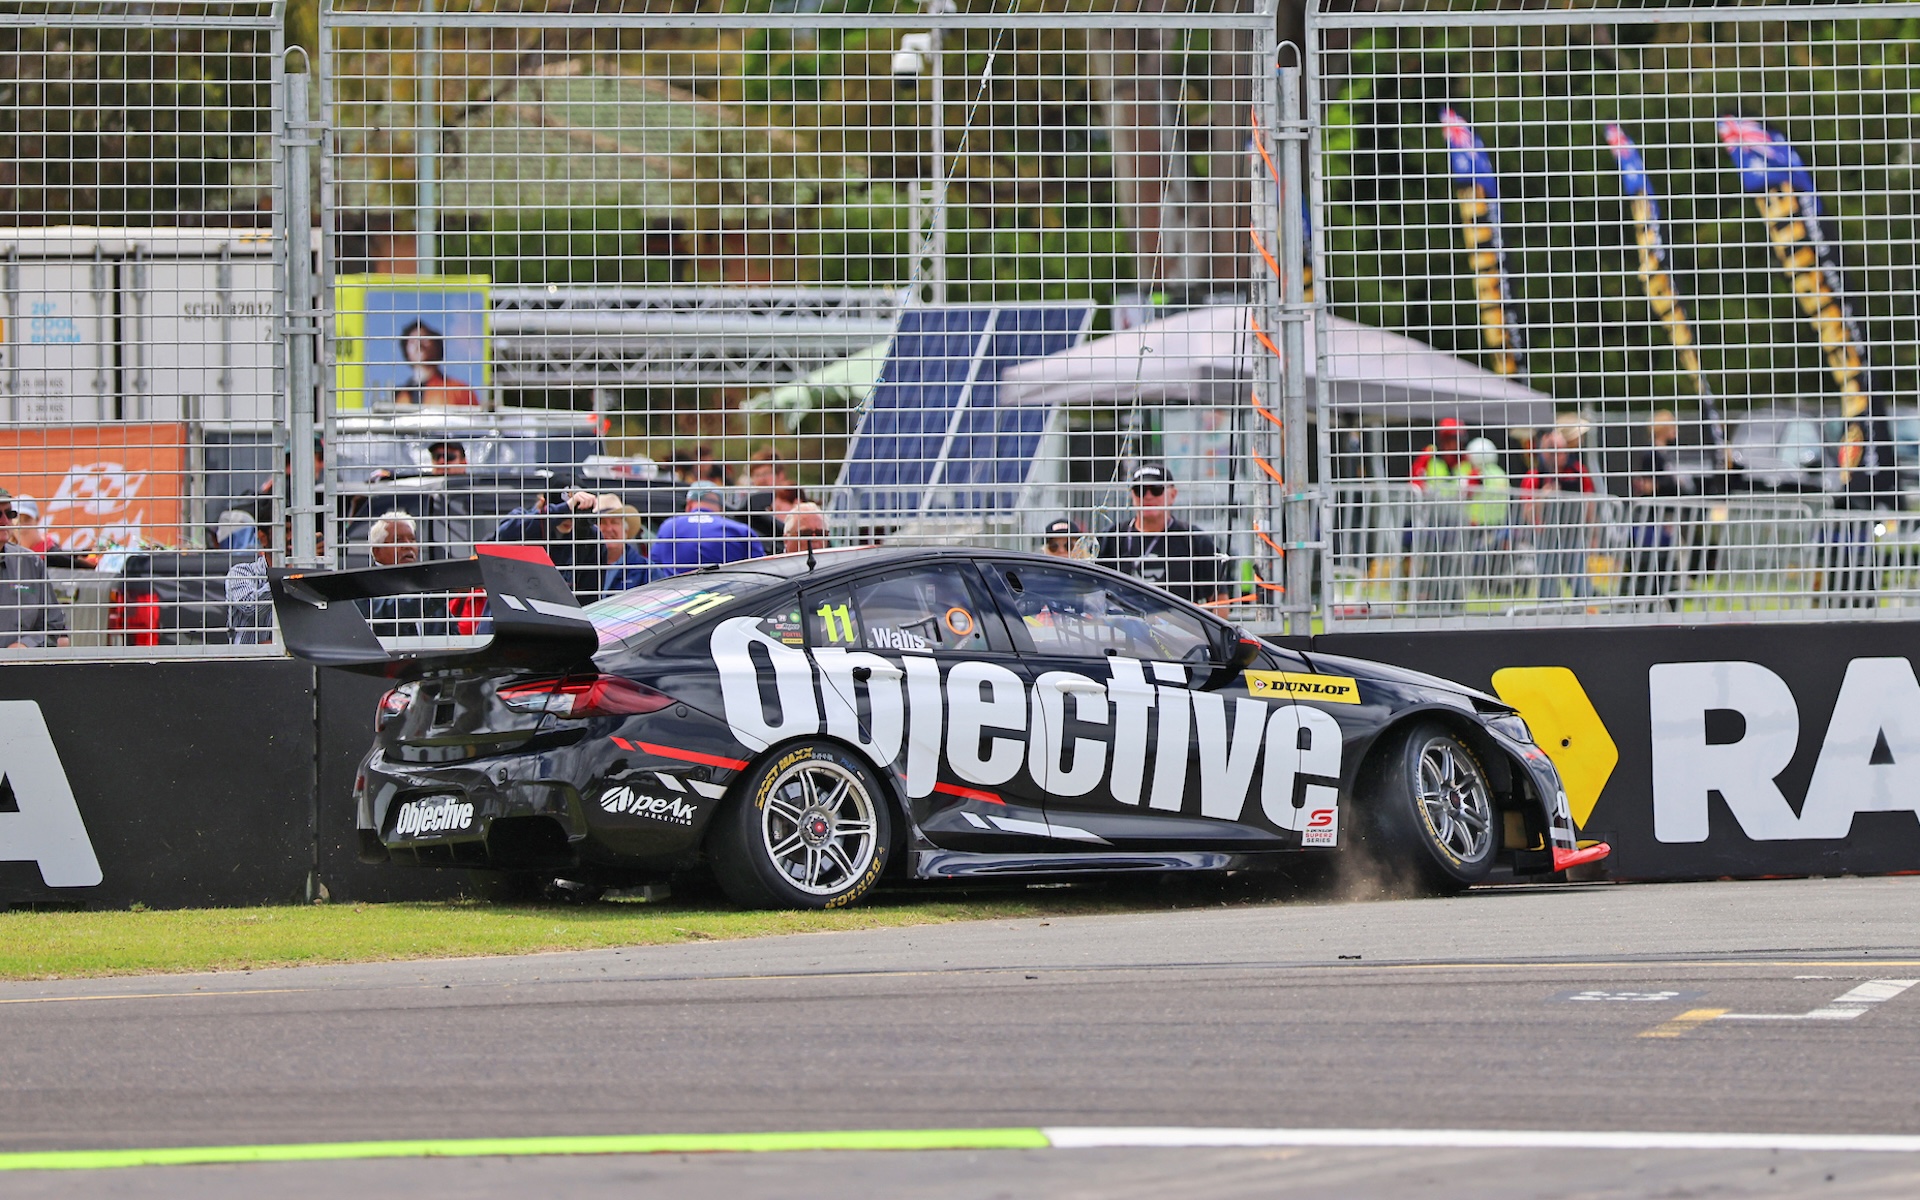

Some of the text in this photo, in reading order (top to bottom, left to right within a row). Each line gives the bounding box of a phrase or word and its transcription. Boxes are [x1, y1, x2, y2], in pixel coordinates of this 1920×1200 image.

[816, 604, 855, 643] 11
[1270, 680, 1350, 696] DUNLOP
[710, 616, 1342, 832] Objective
[778, 746, 814, 771] MAXX
[396, 798, 475, 837] Objective
[636, 810, 692, 826] MARKETING
[824, 856, 883, 910] DUNLOP
